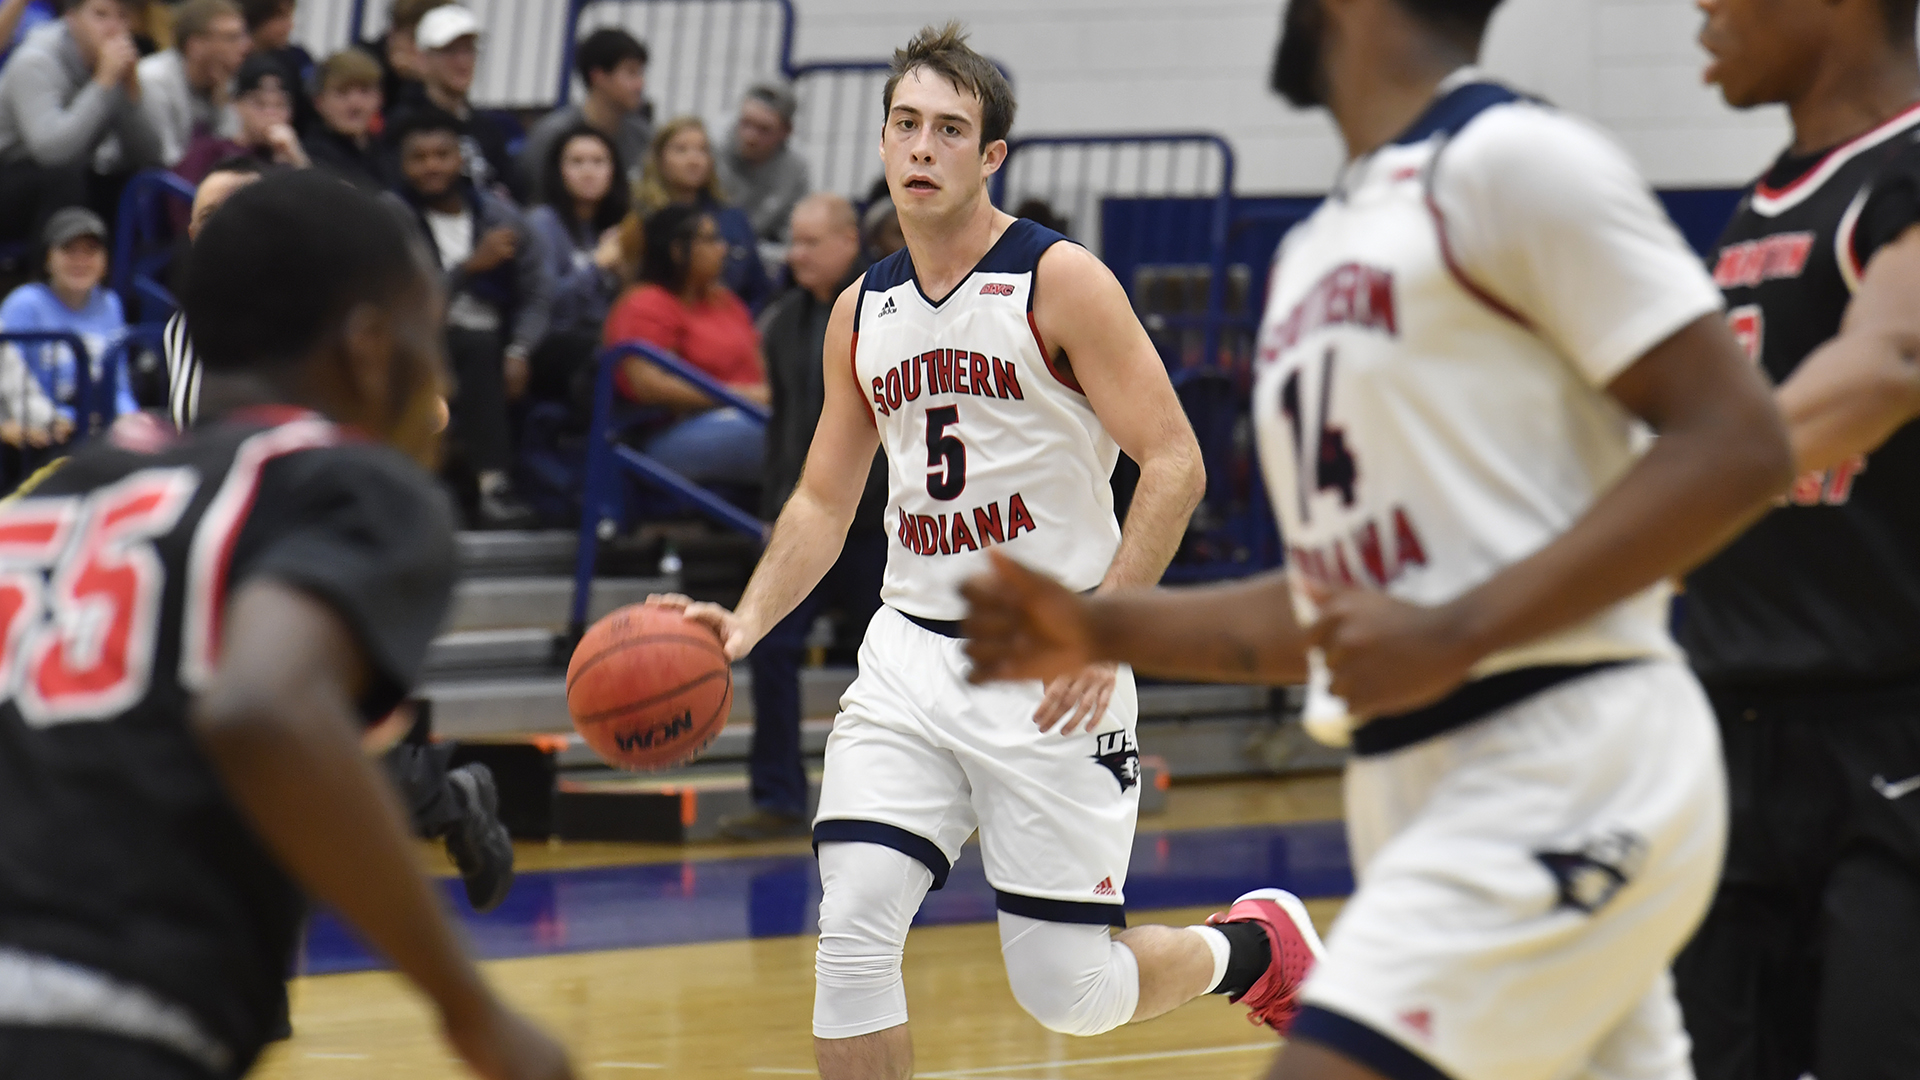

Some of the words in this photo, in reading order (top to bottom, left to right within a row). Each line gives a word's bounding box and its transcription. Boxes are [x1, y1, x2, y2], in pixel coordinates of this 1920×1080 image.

[872, 348, 1024, 417] SOUTHERN
[925, 404, 966, 501] 5
[1280, 343, 1357, 525] 14
[897, 492, 1037, 556] INDIANA
[614, 706, 693, 752] NCAA
